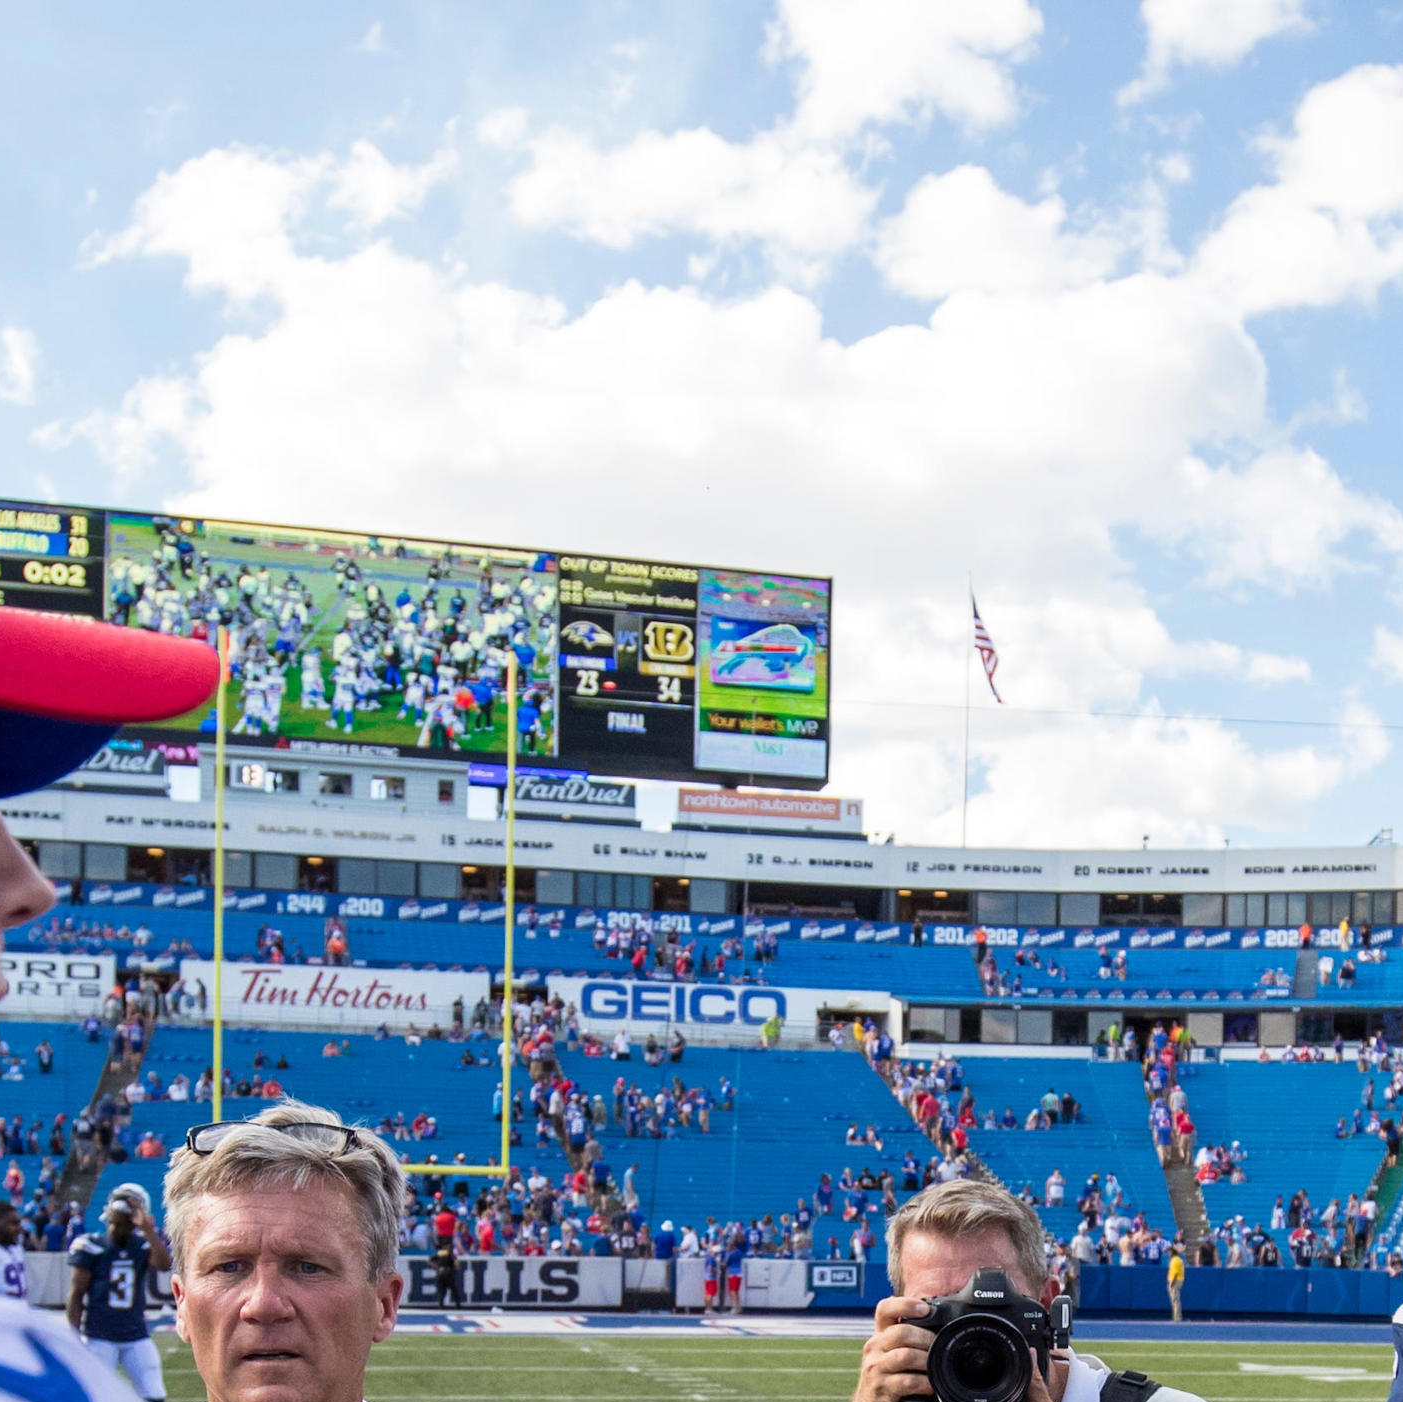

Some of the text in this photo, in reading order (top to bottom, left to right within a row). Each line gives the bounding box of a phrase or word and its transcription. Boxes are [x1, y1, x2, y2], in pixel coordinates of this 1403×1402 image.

[17, 511, 61, 533] ANGELES
[68, 536, 89, 558] 20
[23, 560, 86, 587] 0:02
[560, 557, 588, 571] OUT
[589, 560, 608, 573] OF
[610, 561, 649, 578] TOWN
[650, 565, 698, 583] SCORES
[576, 670, 682, 703] 23 34
[607, 711, 645, 733] FINAL
[707, 712, 737, 729] Your
[80, 748, 158, 773] Duel
[516, 777, 627, 806] FanDuel
[105, 815, 134, 825] PAT
[464, 837, 505, 848] JACK
[619, 847, 658, 858] BILLY
[664, 849, 707, 861] SHAW
[808, 858, 874, 870] SIMPSON
[927, 863, 956, 872] JOE
[963, 864, 1043, 874] FERGUSON
[1074, 865, 1210, 876] 20 ROBERT JAMES
[1244, 864, 1377, 875] EDDIE ABRAMOSKI
[287, 894, 326, 914] 244
[346, 897, 384, 917] 200
[934, 927, 964, 945] 201
[17, 981, 100, 997] RTS
[241, 969, 428, 1011] Tim Hortons
[581, 982, 787, 1025] GEICO
[831, 1269, 853, 1282] NFL
[109, 1266, 135, 1309] 3
[974, 1290, 1004, 1299] Canon
